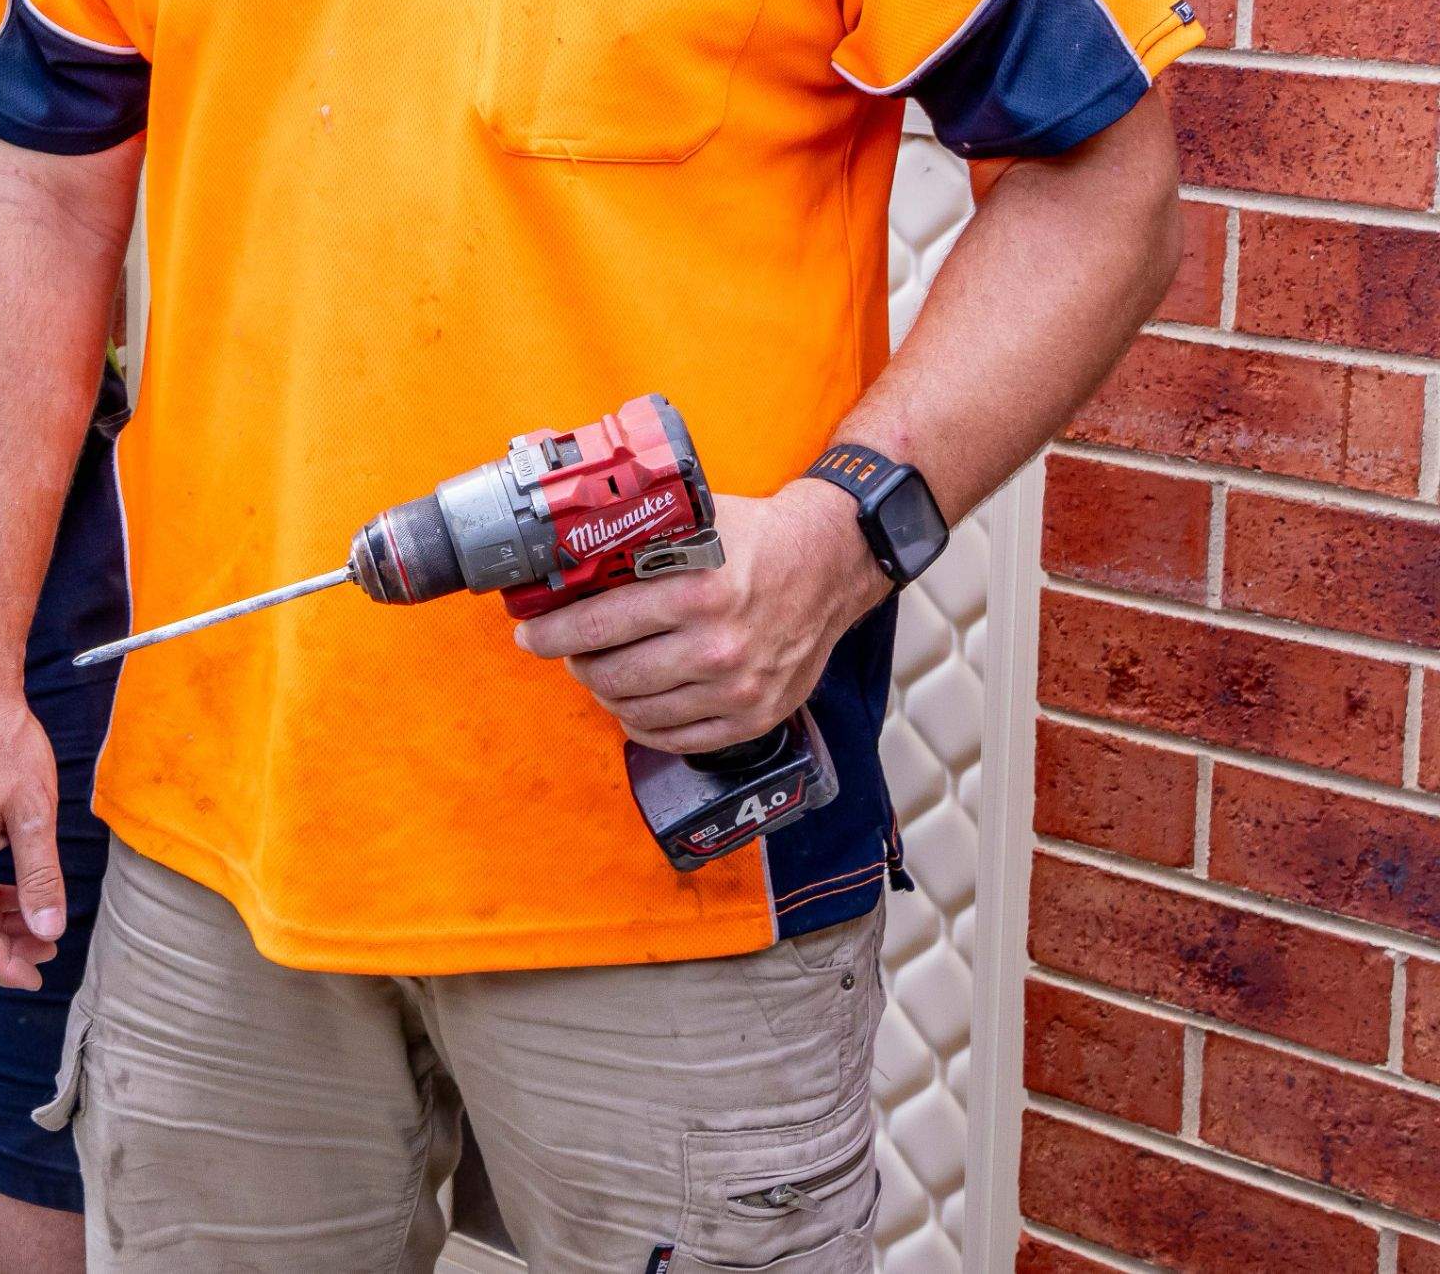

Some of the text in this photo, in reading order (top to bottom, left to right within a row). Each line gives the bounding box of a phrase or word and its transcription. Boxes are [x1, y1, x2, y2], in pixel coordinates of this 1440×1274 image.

[565, 491, 677, 553] Milwaukee
[735, 791, 788, 826] 4.0
[691, 824, 719, 844] M12
